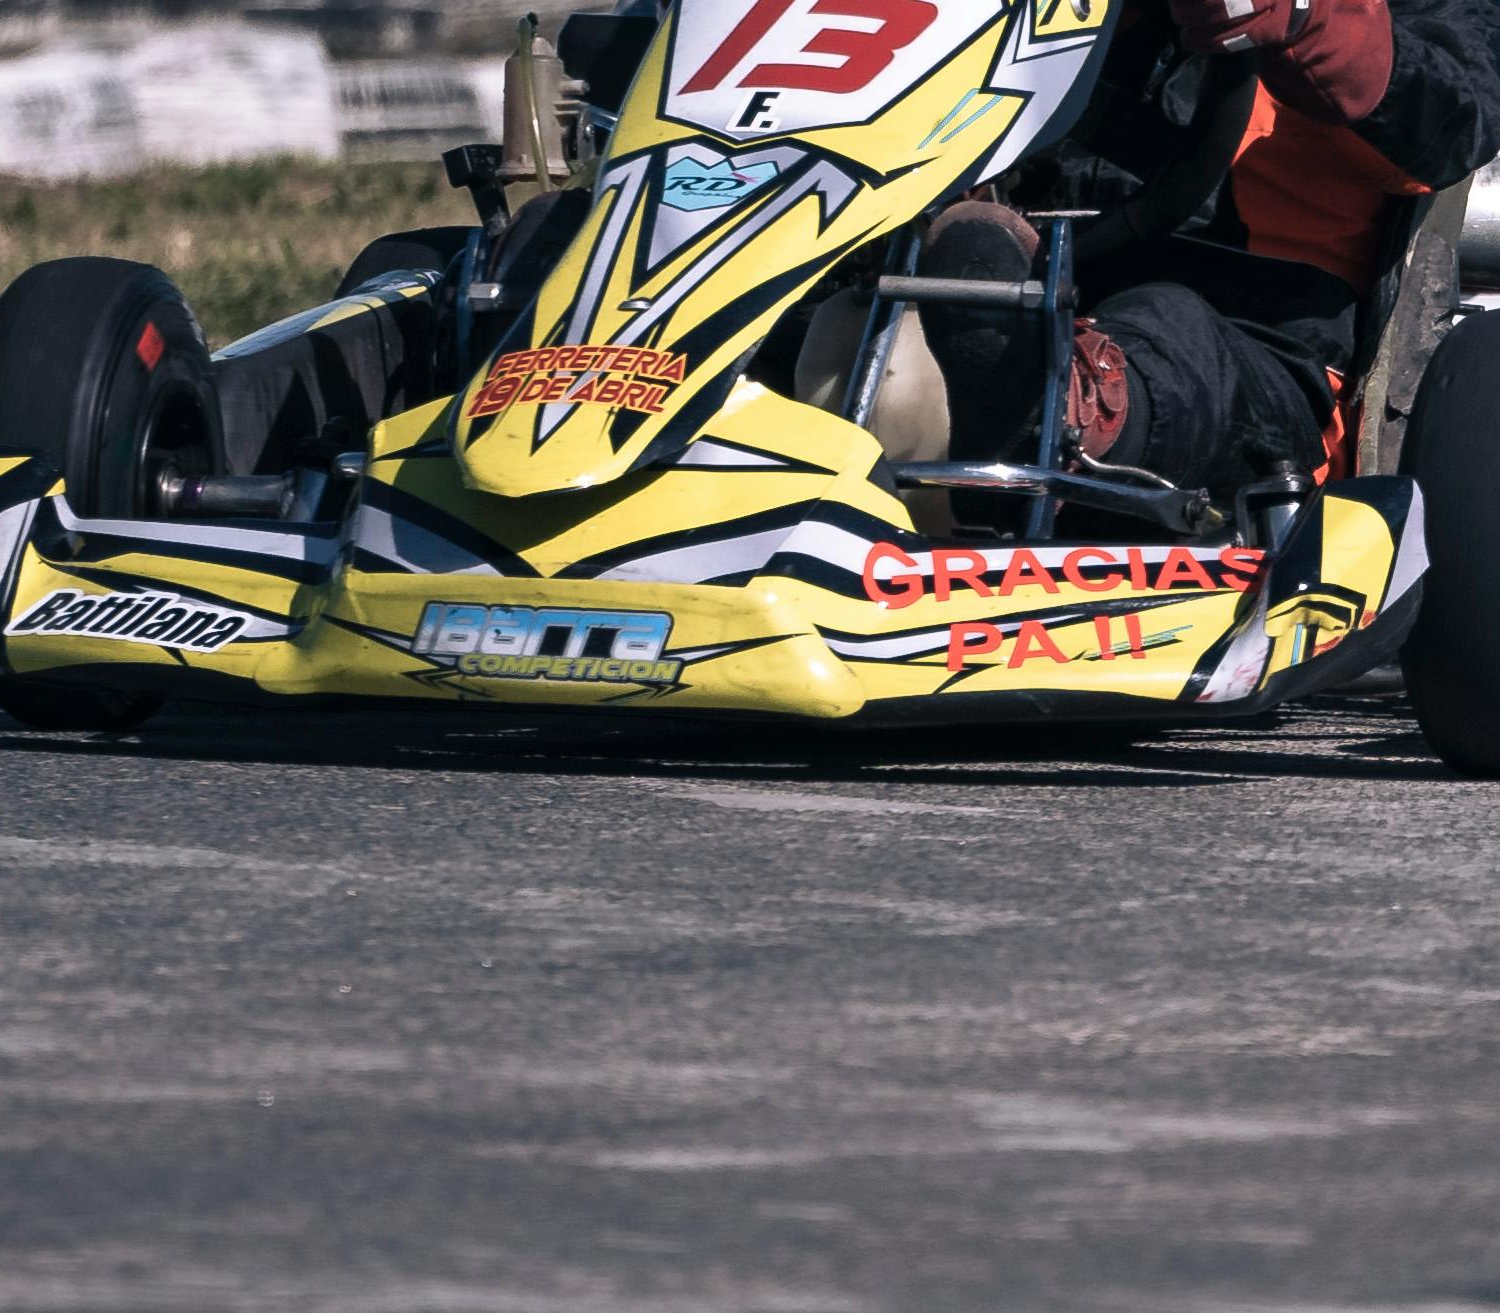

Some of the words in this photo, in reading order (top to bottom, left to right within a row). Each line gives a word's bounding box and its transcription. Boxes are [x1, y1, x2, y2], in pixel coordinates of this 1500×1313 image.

[665, 176, 747, 192] RD
[487, 345, 687, 384] FERRETERIA
[466, 376, 524, 420] 19
[518, 377, 576, 404] DE
[570, 379, 669, 415] ABRIL
[862, 541, 1267, 609] GRACIAS
[13, 592, 246, 648] Battilana
[946, 620, 1069, 671] PA
[458, 654, 680, 682] COMPETICION
